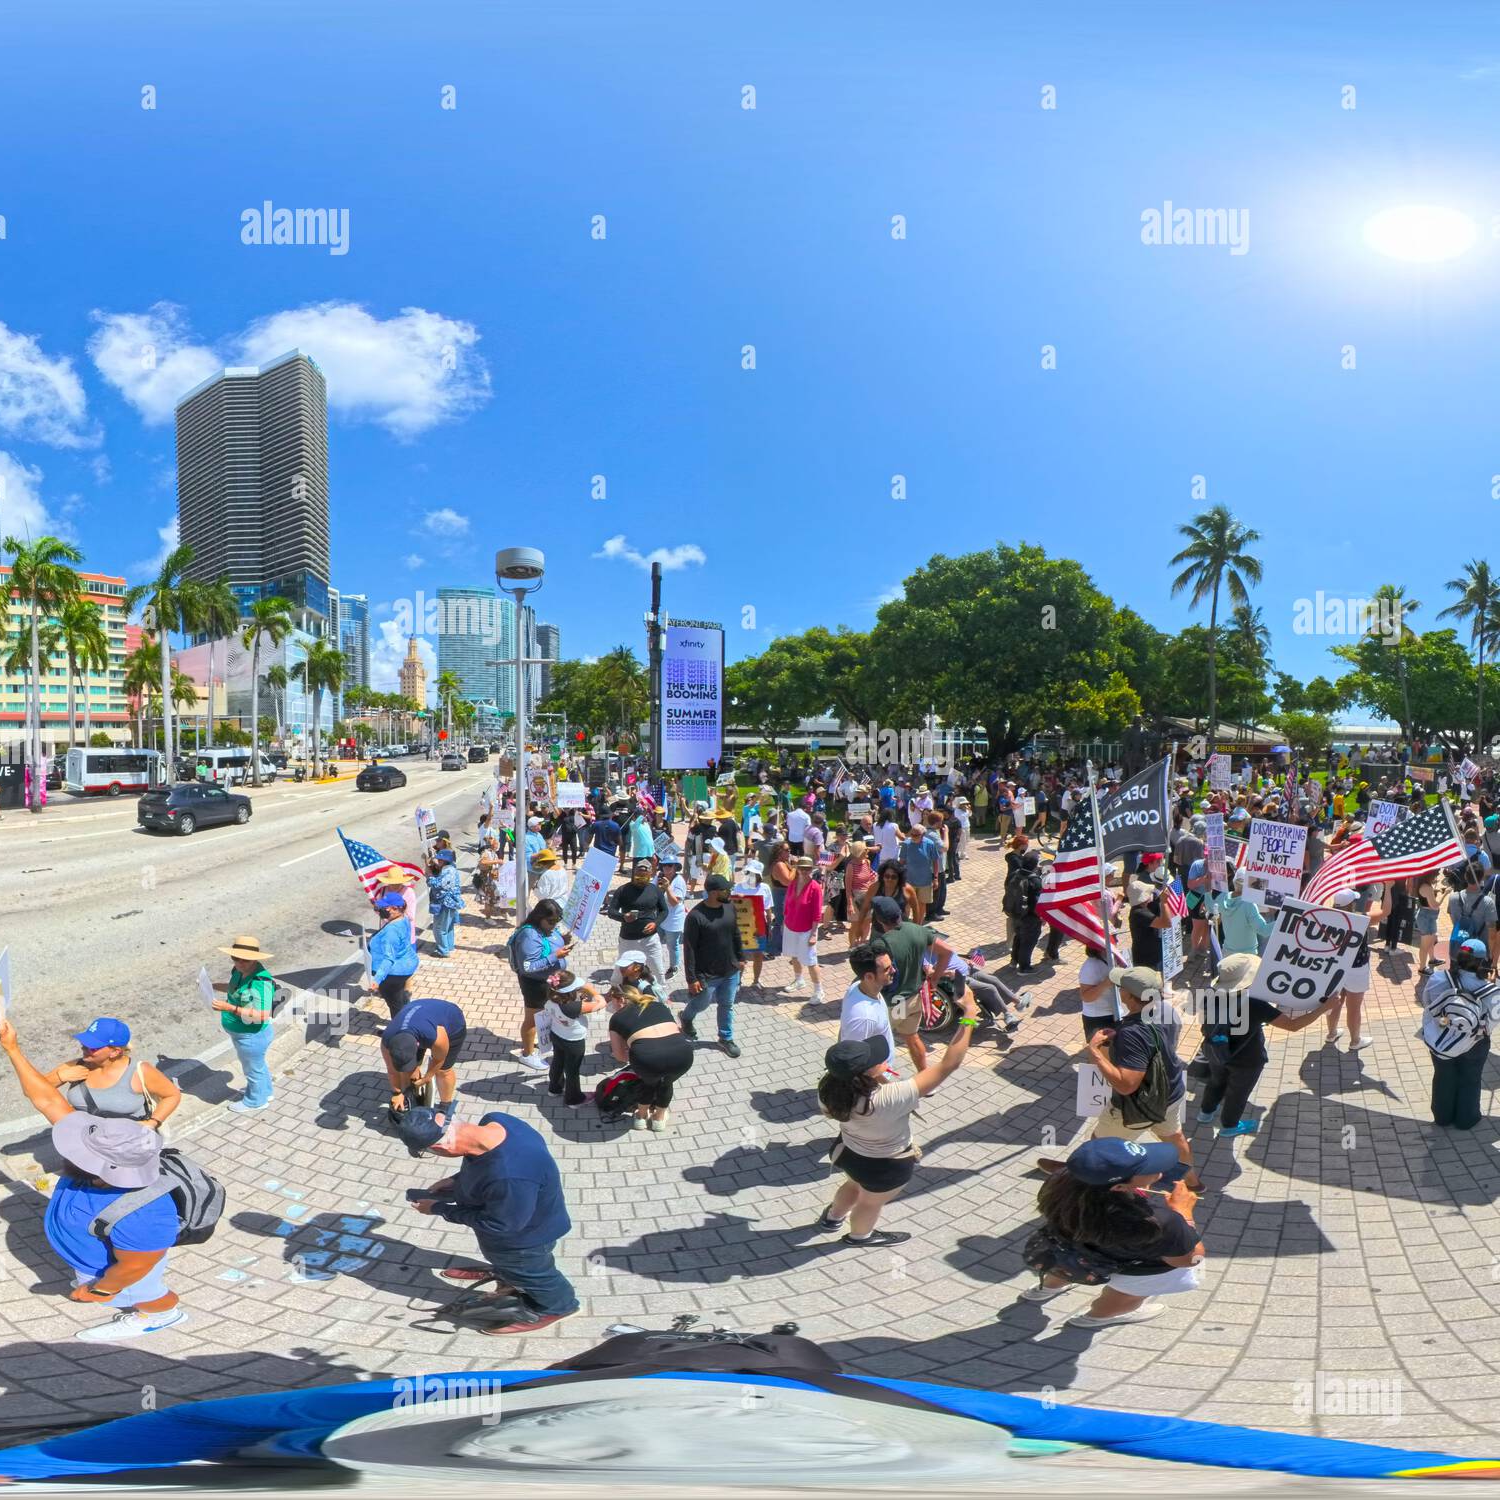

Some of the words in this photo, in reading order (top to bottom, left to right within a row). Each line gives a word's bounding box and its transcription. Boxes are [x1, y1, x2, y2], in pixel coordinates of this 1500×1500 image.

[667, 618, 703, 629] AYFRONT
[680, 640, 705, 649] xfinity
[666, 683, 685, 691] THE
[687, 684, 707, 692] WIFI
[666, 690, 717, 700] BOOMING
[667, 709, 716, 719] SUMMER
[1253, 822, 1307, 841] DISAPPEARING
[1261, 836, 1297, 855] PEOPLE
[1257, 851, 1266, 862] IS
[1271, 854, 1290, 866] NOT
